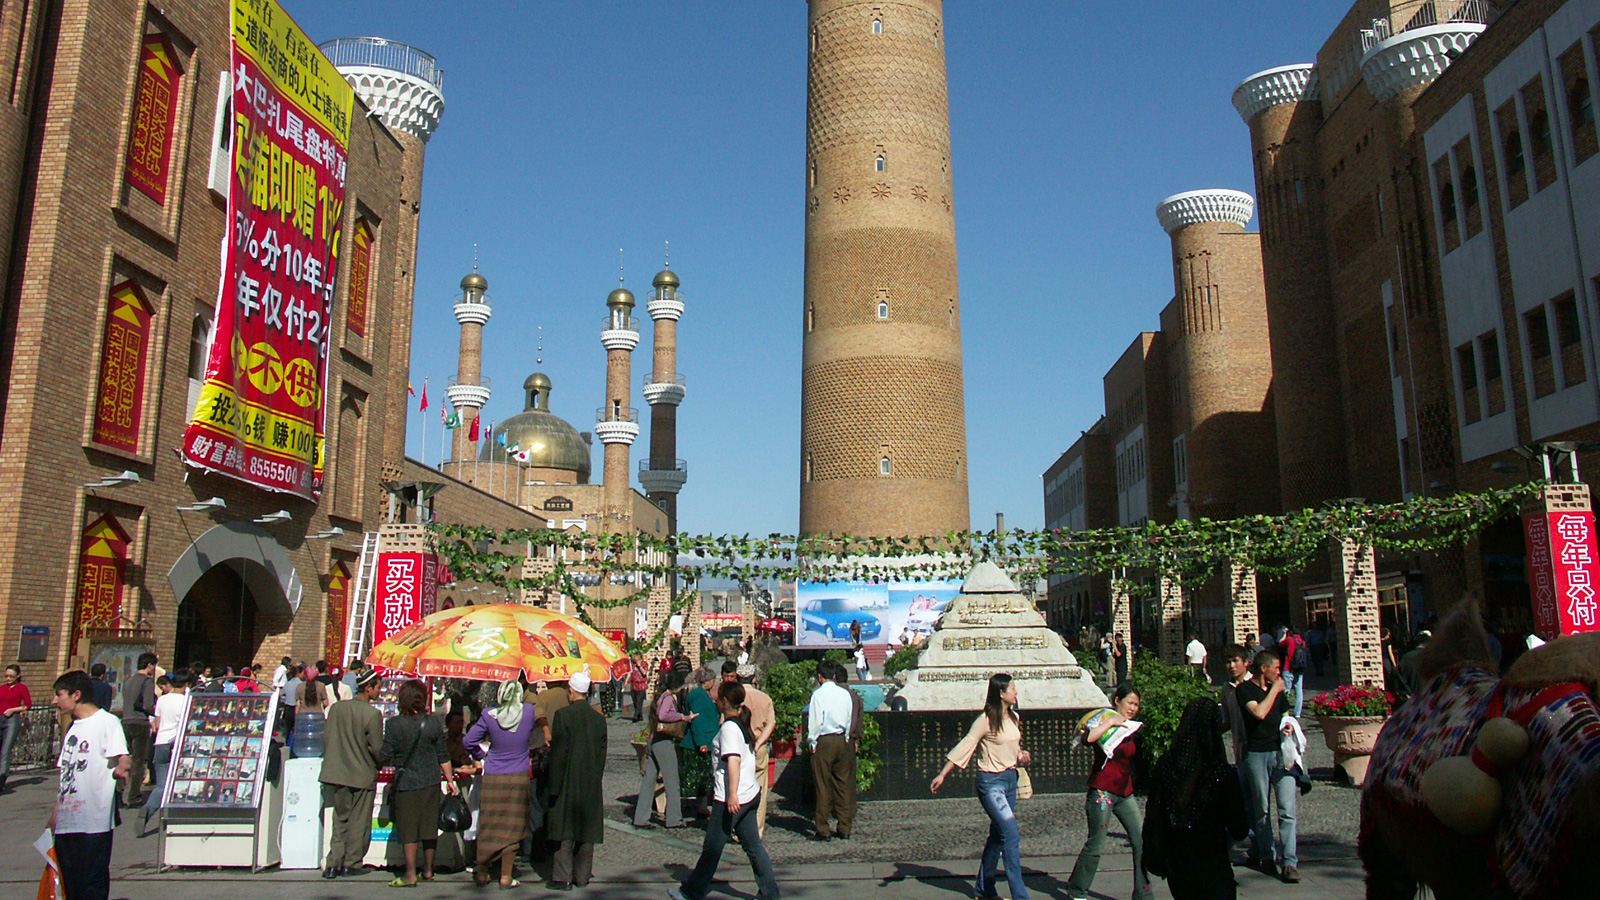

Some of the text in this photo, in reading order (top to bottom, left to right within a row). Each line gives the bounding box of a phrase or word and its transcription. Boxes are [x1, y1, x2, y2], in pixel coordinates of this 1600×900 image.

[146, 82, 170, 175] 国际大巴扎
[117, 329, 141, 428] 国际大巴扎
[1557, 514, 1597, 634] 每年只付
